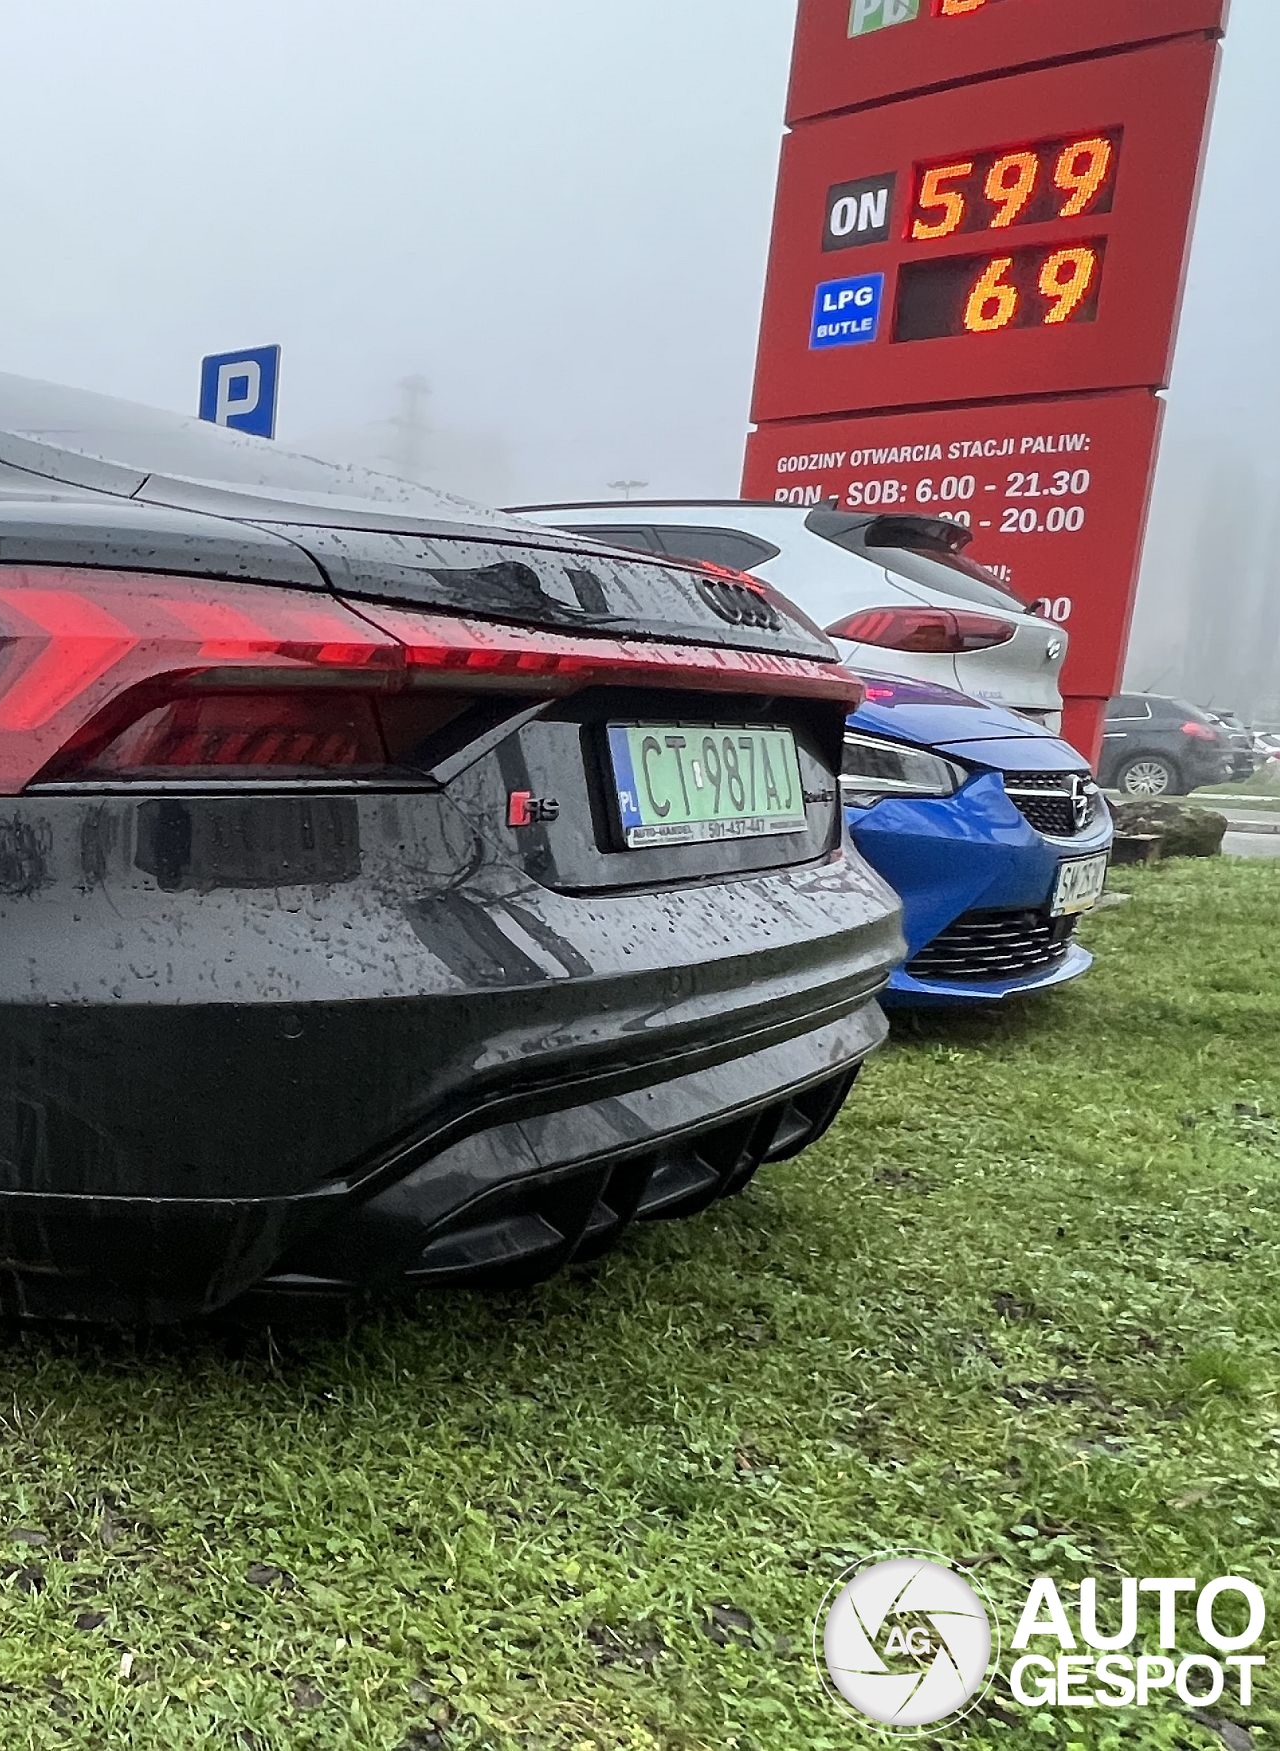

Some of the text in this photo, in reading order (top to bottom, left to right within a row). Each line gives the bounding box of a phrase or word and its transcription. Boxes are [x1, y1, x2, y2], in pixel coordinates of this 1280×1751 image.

[912, 138, 1111, 239] 599
[830, 188, 888, 236] ON
[823, 286, 873, 311] LPG
[964, 248, 1095, 331] 69
[816, 318, 873, 338] BUTLE
[216, 361, 260, 426] P
[776, 433, 1091, 473] GODZINY OTWARCIA STACJI PALIW:
[774, 484, 822, 506] PON
[846, 480, 908, 506] SOB:
[915, 475, 976, 503] 6.00
[1005, 469, 1090, 497] 21.30
[999, 506, 1086, 533] 20.00
[641, 735, 792, 817] CT 987AJ
[619, 791, 637, 813] PL
